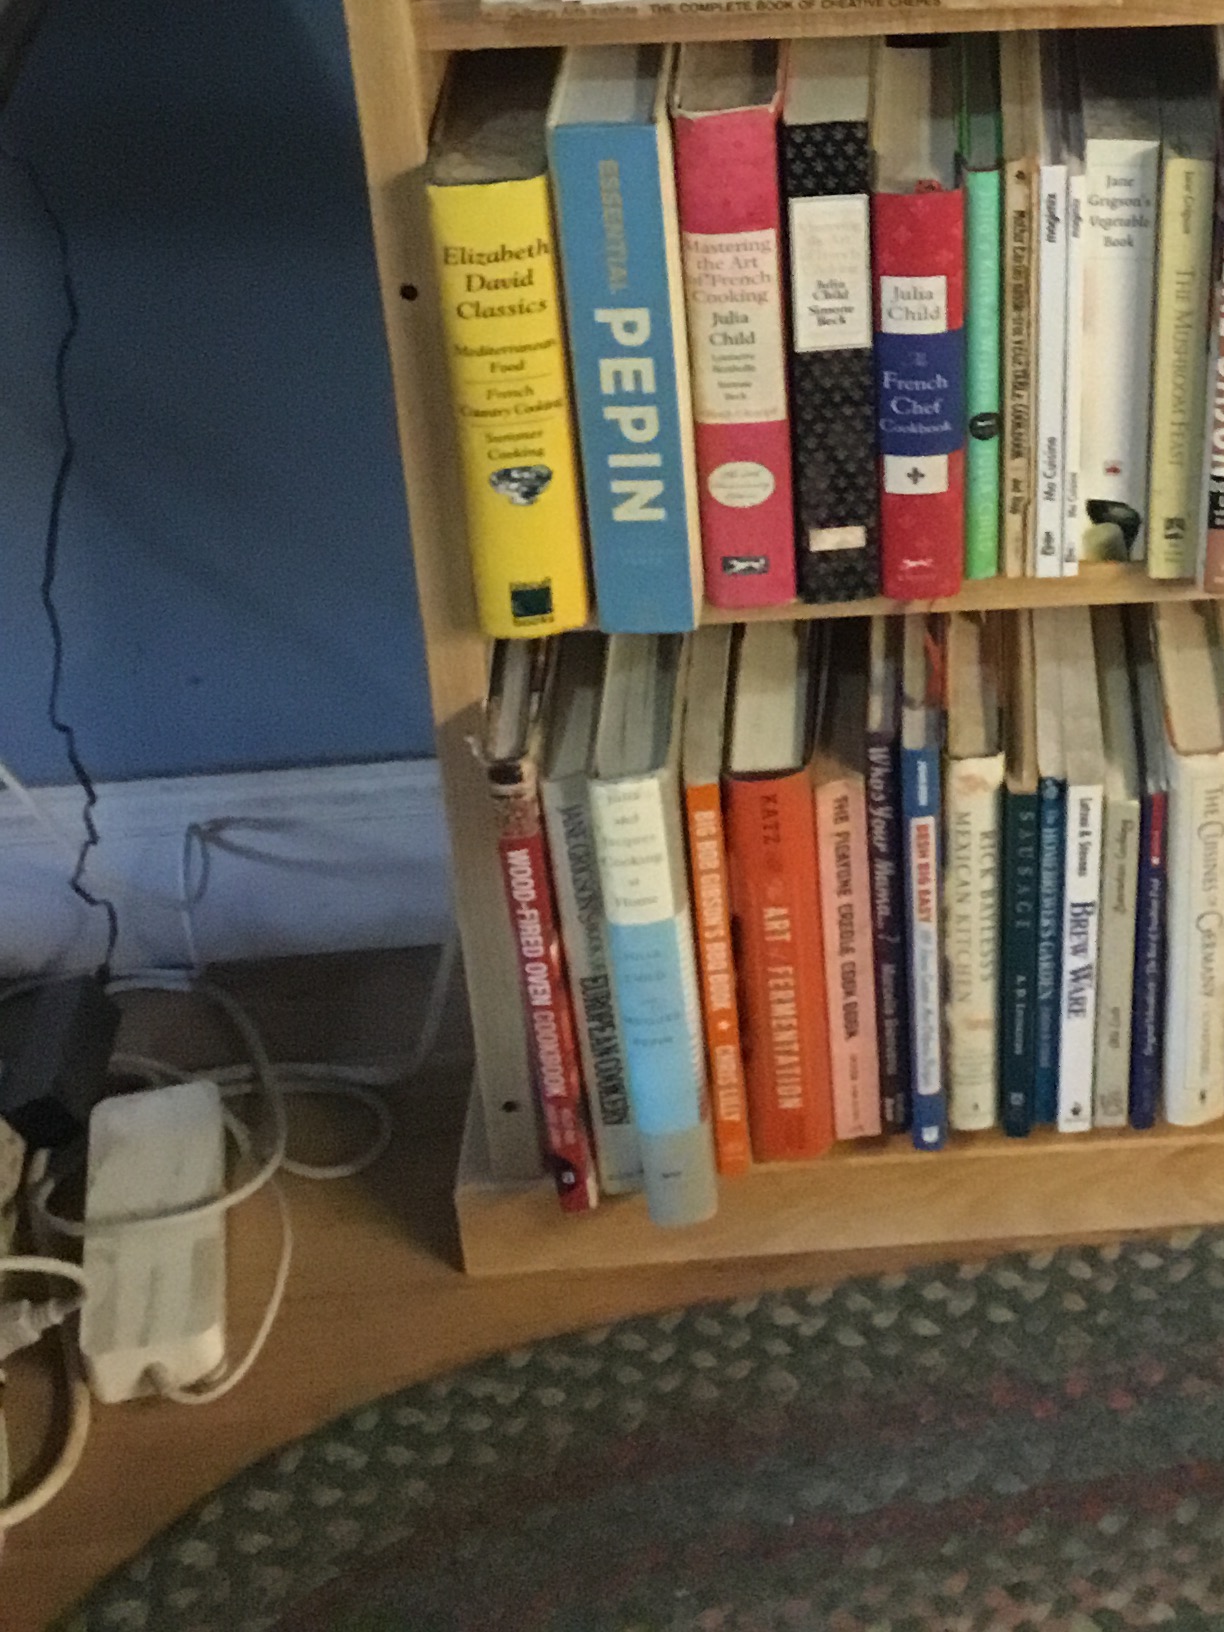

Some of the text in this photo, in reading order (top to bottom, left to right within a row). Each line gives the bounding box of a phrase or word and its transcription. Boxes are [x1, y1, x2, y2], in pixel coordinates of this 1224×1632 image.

[442, 238, 549, 321] Elizabeth David Classics
[890, 285, 935, 303] Julia
[711, 310, 750, 328] Julia
[886, 302, 942, 322] Child
[709, 331, 755, 346] Child
[881, 370, 949, 392] French
[597, 304, 668, 523] PEPIN
[889, 394, 943, 415] Chef
[762, 793, 780, 845] KATZ
[914, 823, 930, 859] BESH
[916, 861, 931, 885] BIG
[1014, 811, 1034, 929] SAUSAGE
[916, 888, 933, 923] EASY
[954, 811, 972, 1002] MEXICAN KITCHEN
[508, 847, 567, 1098] WOOD-FIRED OVEN COOKBOOK
[1066, 900, 1096, 1019] BREW WARE
[763, 905, 802, 1109] ART FERMENTATION
